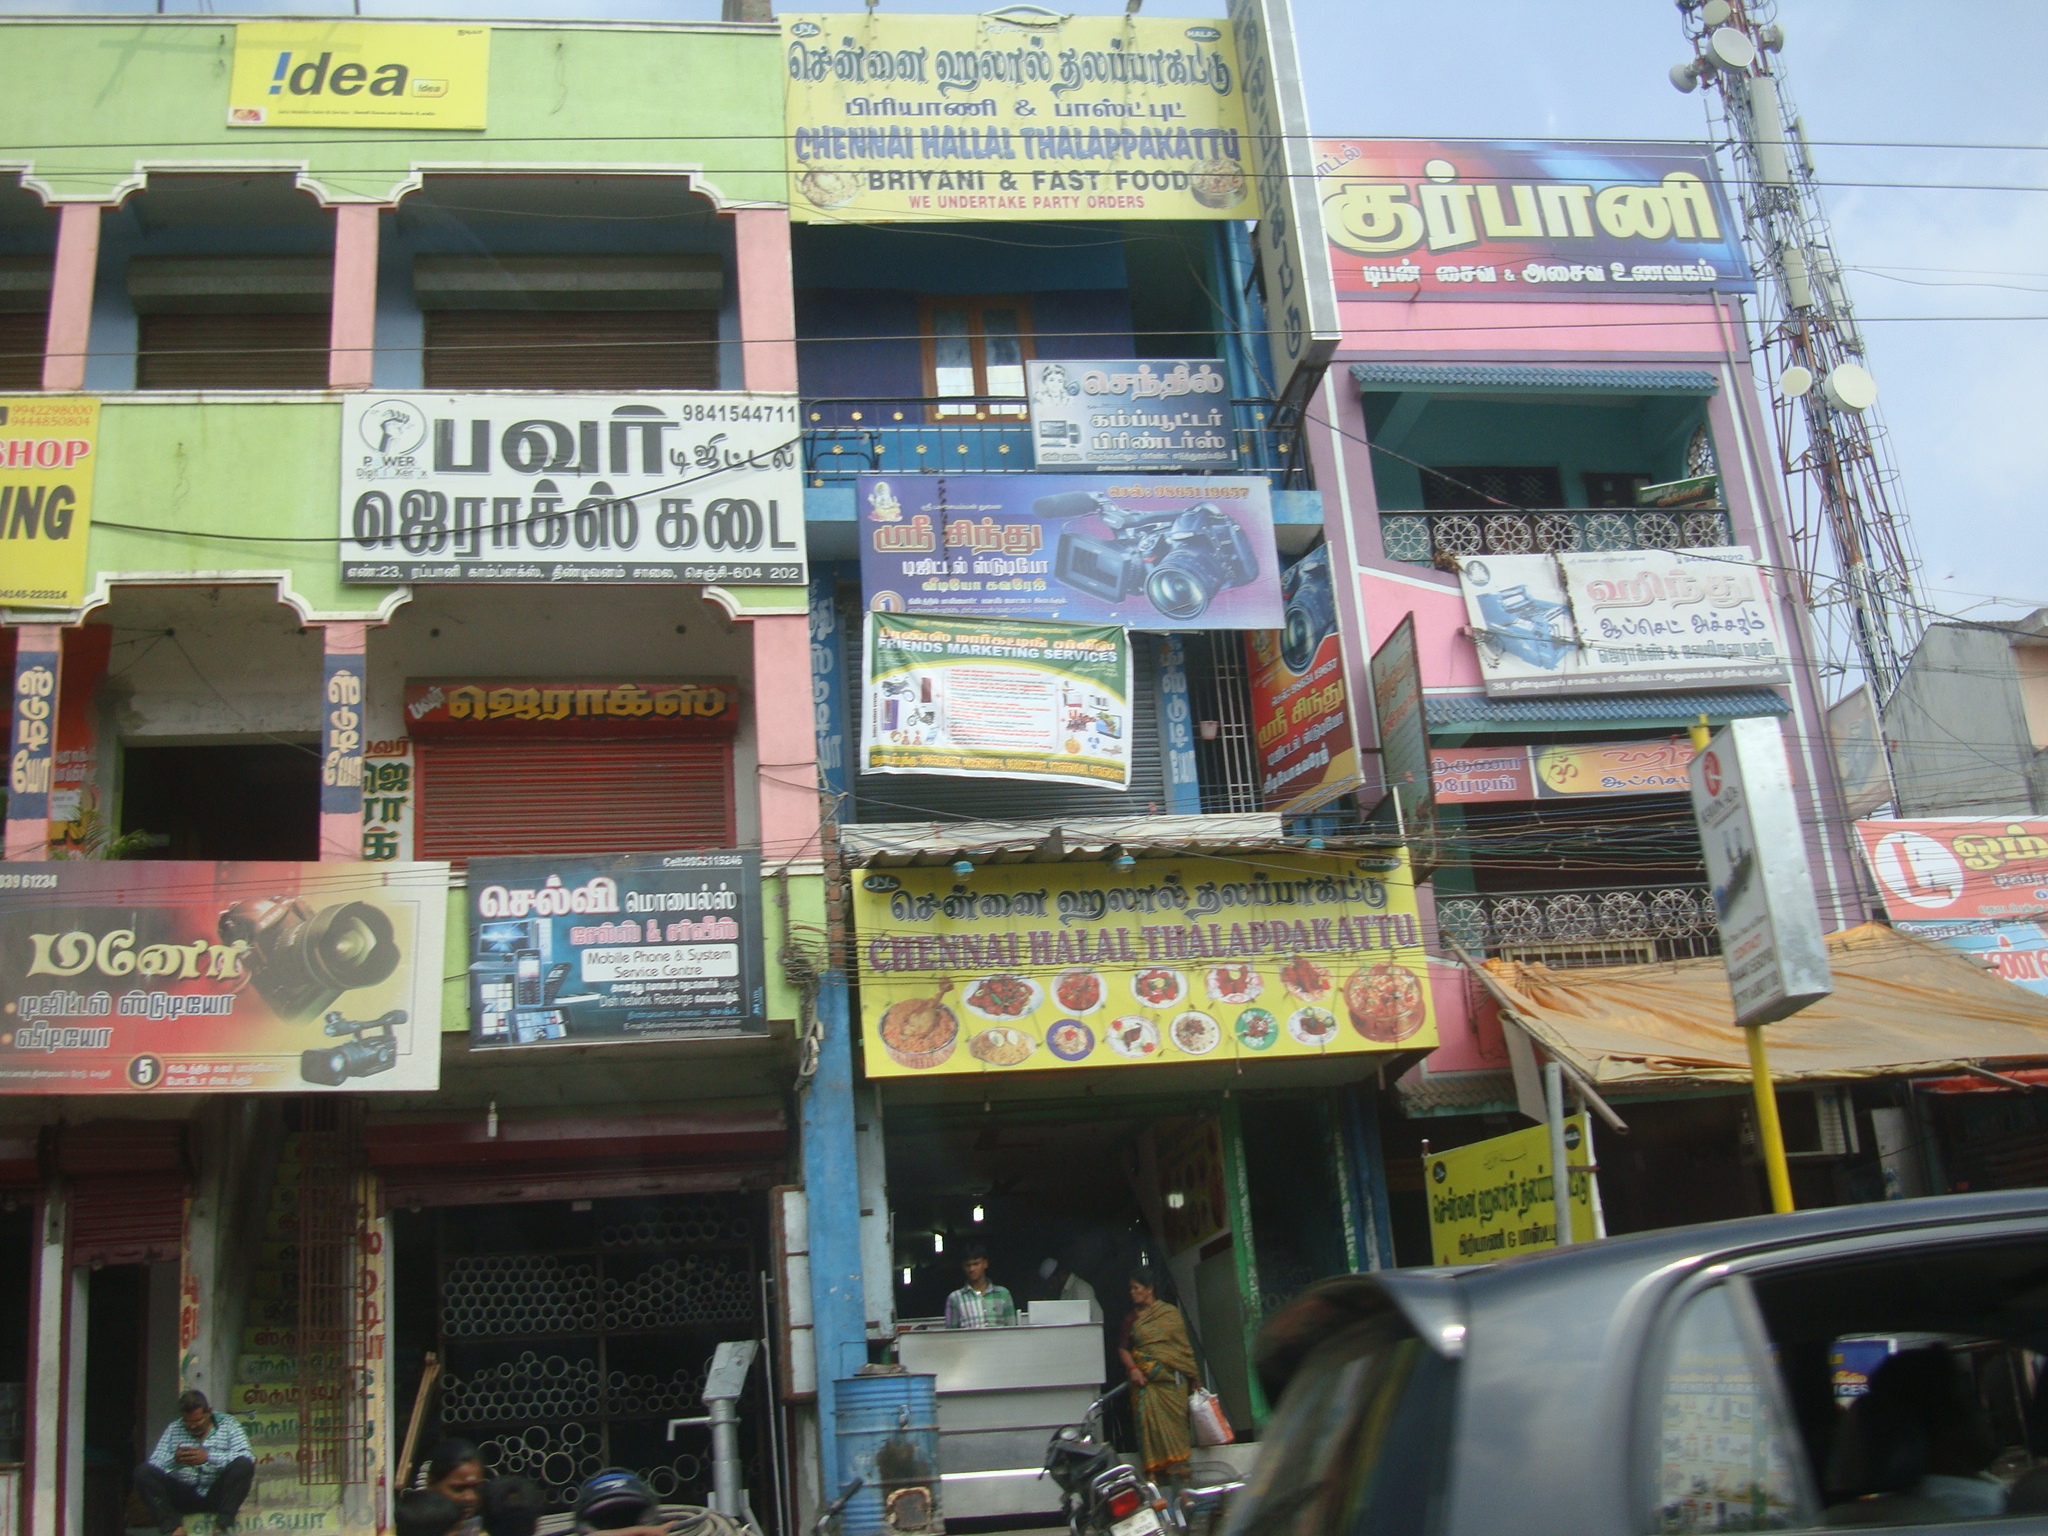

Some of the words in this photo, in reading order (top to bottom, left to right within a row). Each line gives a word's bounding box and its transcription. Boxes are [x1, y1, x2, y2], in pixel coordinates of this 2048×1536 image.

[788, 36, 930, 85] சென்னை
[936, 36, 1053, 98] ஹலால்
[1048, 38, 1233, 97] தலப்பாகட்டு
[845, 97, 998, 117] பிரியாணி
[1014, 99, 1038, 117] &
[794, 125, 916, 161] CHENNAI
[1020, 126, 1240, 162] THALAPPAKATTU
[867, 170, 985, 192] BRIYANI
[999, 171, 1020, 192] &
[1032, 170, 1102, 192] FAST
[1115, 170, 1190, 192] FOOD
[909, 195, 932, 209] WE
[937, 195, 1027, 209] UNDERTAKE
[1032, 195, 1082, 210] PARTY
[1087, 195, 1146, 209] ORDERS
[1323, 159, 1725, 253] குர்பானி
[1504, 268, 1517, 283] &
[1611, 257, 1718, 284] உணவகம்
[1082, 364, 1224, 401] செந்தில்
[682, 404, 797, 423] 9841544711
[1090, 408, 1223, 432] கம்ப்யூட்டர்
[0, 440, 90, 468] HOP
[433, 404, 681, 476] பவர்
[669, 433, 796, 475] டிஜிட்டல்
[1091, 431, 1226, 450] பிரிண்டர்ஸ்
[353, 479, 638, 560] ஜெராக்ஸ்
[656, 497, 798, 551] கடை
[945, 516, 1043, 556] சிந்து
[552, 564, 625, 581] திண்டிவனம்
[769, 567, 799, 579] 202
[902, 556, 969, 577] டிஜிட்டல்
[973, 556, 1050, 577] ஸ்டுடியோ
[1600, 617, 1684, 640] ஆப்செட்
[1691, 608, 1765, 636] அச்சகம்
[878, 637, 943, 654] FRIENDS
[946, 642, 1040, 659] MARKETING
[1044, 649, 1118, 663] SERVICES
[449, 684, 728, 721] ஜெராக்ஸ்
[478, 874, 620, 918] செல்வி
[625, 882, 738, 914] மொபைல்ஸ்
[1057, 874, 1192, 926] ஹலால்
[646, 919, 662, 942] &
[867, 932, 1019, 973] CHENNAI
[1027, 926, 1138, 966] HALAL
[1141, 913, 1418, 963] THALAPPAKATTU
[25, 928, 248, 981] மனோ
[586, 950, 632, 966] Mobile
[633, 949, 671, 964] Phone
[675, 950, 685, 961] &
[687, 948, 733, 964] System
[614, 965, 658, 978] Service
[662, 963, 703, 977] Centre
[18, 990, 111, 1020] டிஜிட்டல்
[118, 989, 236, 1020] ஸ்டுடியோ
[15, 1022, 114, 1052] வீடியோ
[138, 1057, 153, 1083] 5
